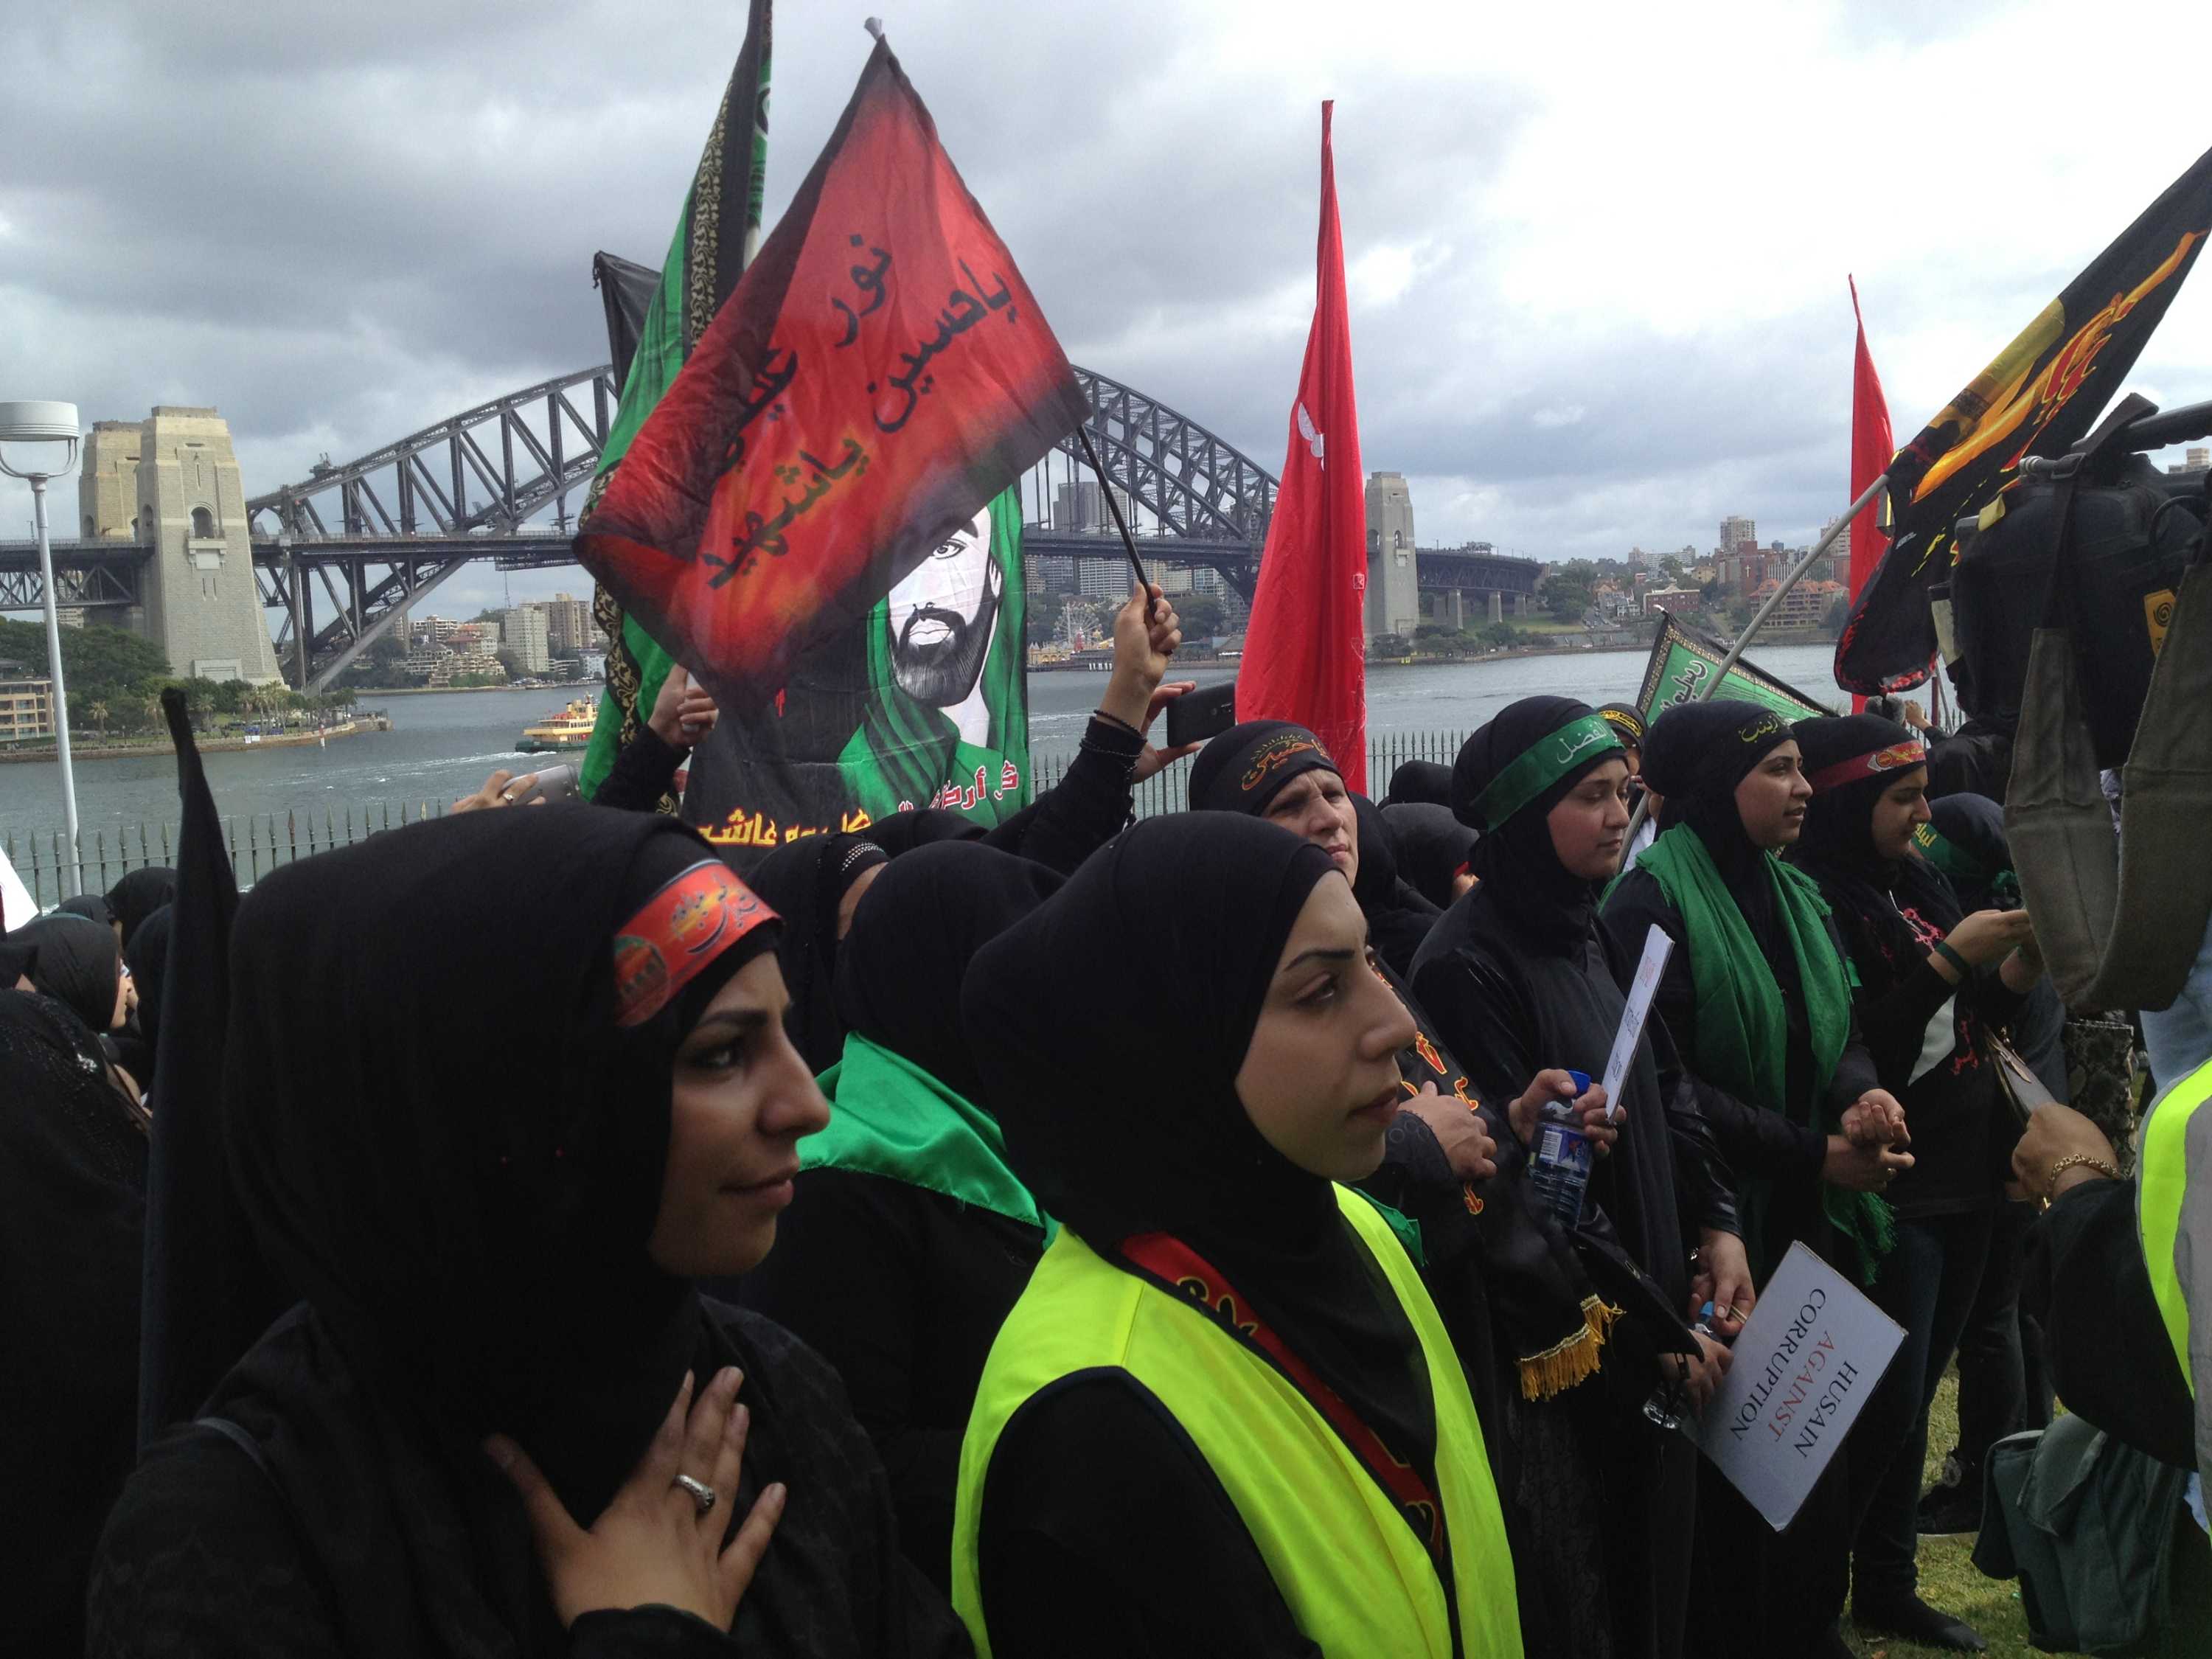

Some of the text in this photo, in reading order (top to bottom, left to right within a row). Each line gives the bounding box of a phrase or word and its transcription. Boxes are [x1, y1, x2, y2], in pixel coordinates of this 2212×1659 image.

[1728, 1287, 1827, 1441] CORRUPTION
[1768, 1329, 1836, 1444] AGAINST
[1793, 1360, 1859, 1458] HUSAIN
